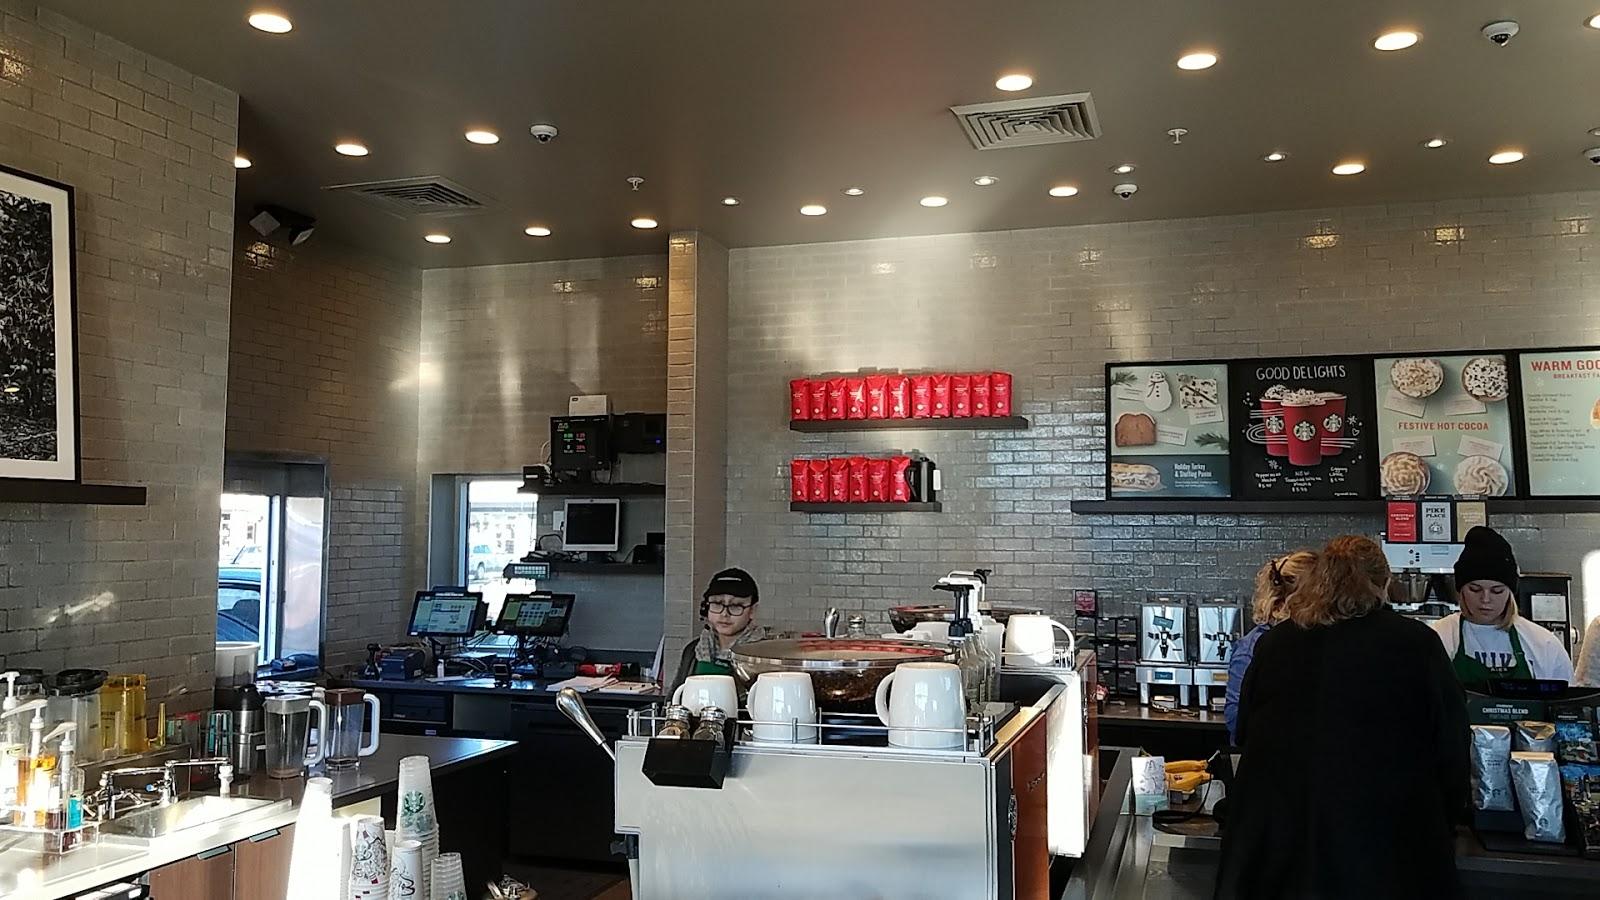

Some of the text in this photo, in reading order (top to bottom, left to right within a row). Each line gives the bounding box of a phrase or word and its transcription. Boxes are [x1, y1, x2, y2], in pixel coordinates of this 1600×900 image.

[1531, 360, 1571, 371] WARM
[1256, 365, 1346, 380] GOOD DELIGHTS
[1398, 422, 1489, 430] FESTIVE HOT COCOA
